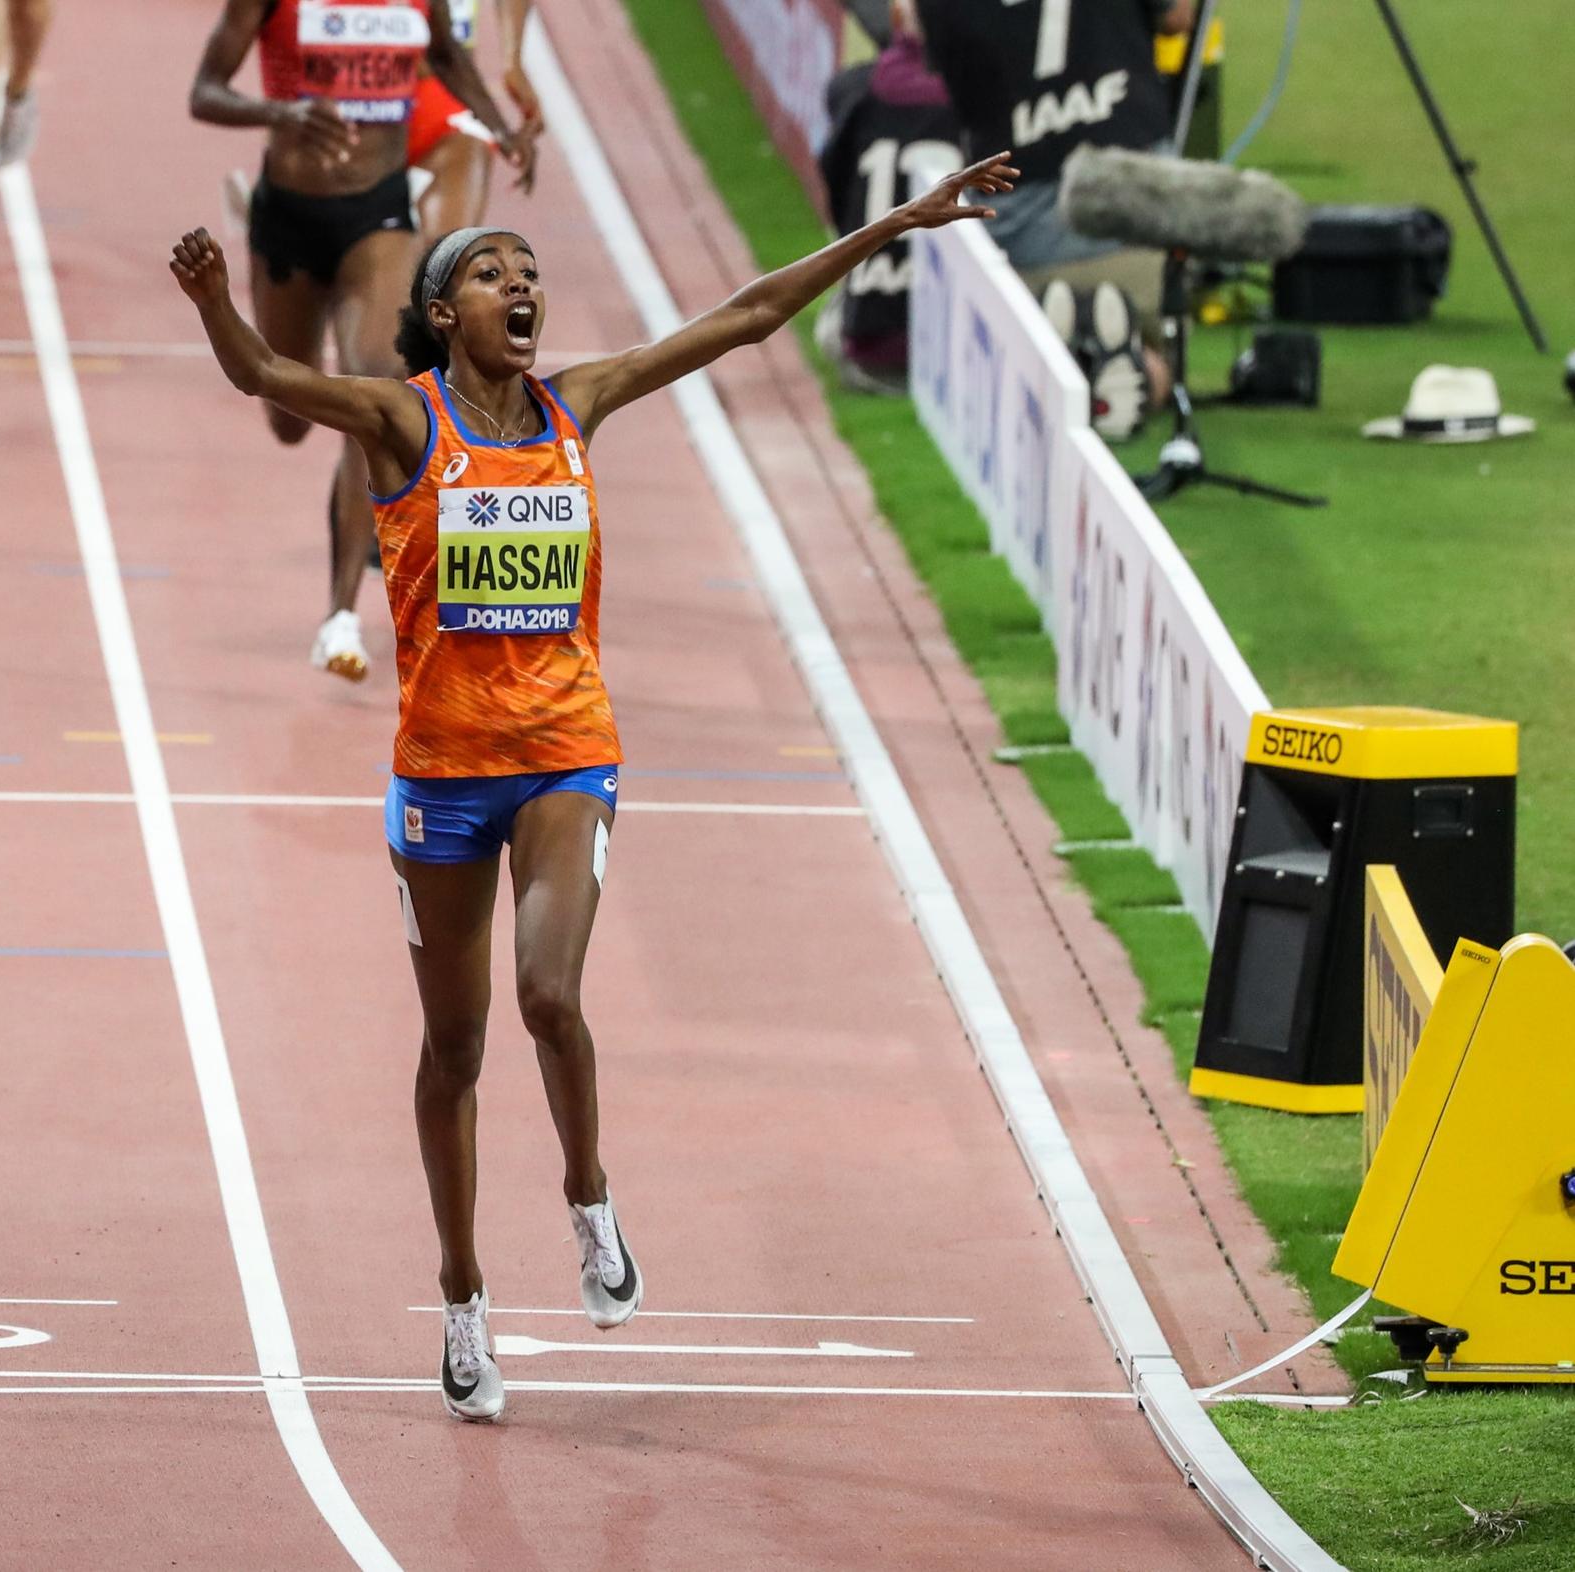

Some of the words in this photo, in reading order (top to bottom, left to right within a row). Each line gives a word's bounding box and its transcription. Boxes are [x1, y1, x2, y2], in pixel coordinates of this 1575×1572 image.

[351, 11, 412, 36] QNB
[1011, 68, 1130, 147] IAAF
[507, 495, 573, 523] QNB
[447, 543, 580, 591] HASSAN
[466, 607, 570, 630] DOHA2019
[1262, 723, 1342, 764] SEIKO
[1461, 948, 1492, 965] SEIKO
